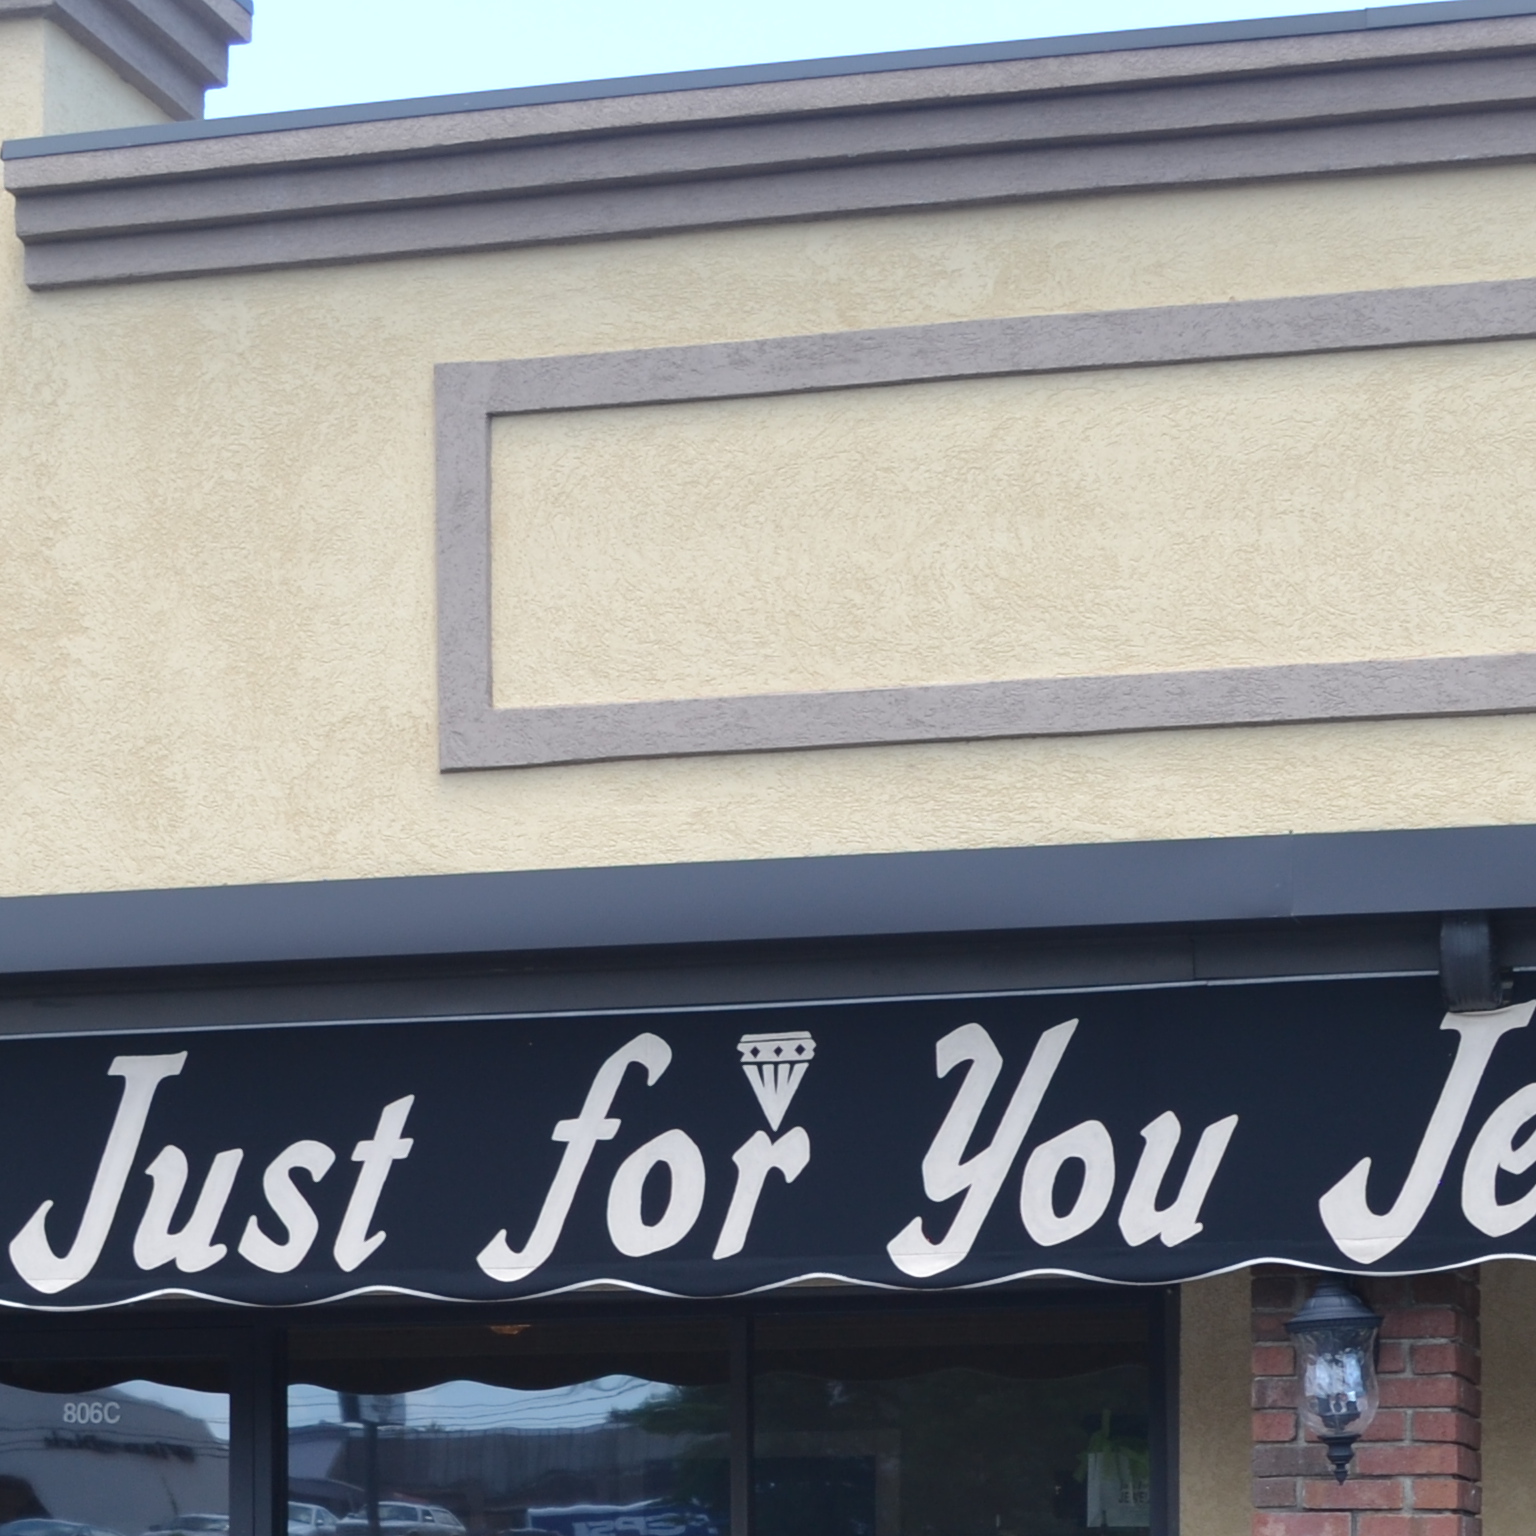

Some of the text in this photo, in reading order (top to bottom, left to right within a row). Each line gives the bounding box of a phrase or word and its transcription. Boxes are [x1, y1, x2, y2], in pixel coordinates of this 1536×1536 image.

[9, 1051, 415, 1294] Just
[476, 1032, 811, 1283] for
[887, 1019, 1239, 1278] You
[63, 1401, 121, 1425] 806C
